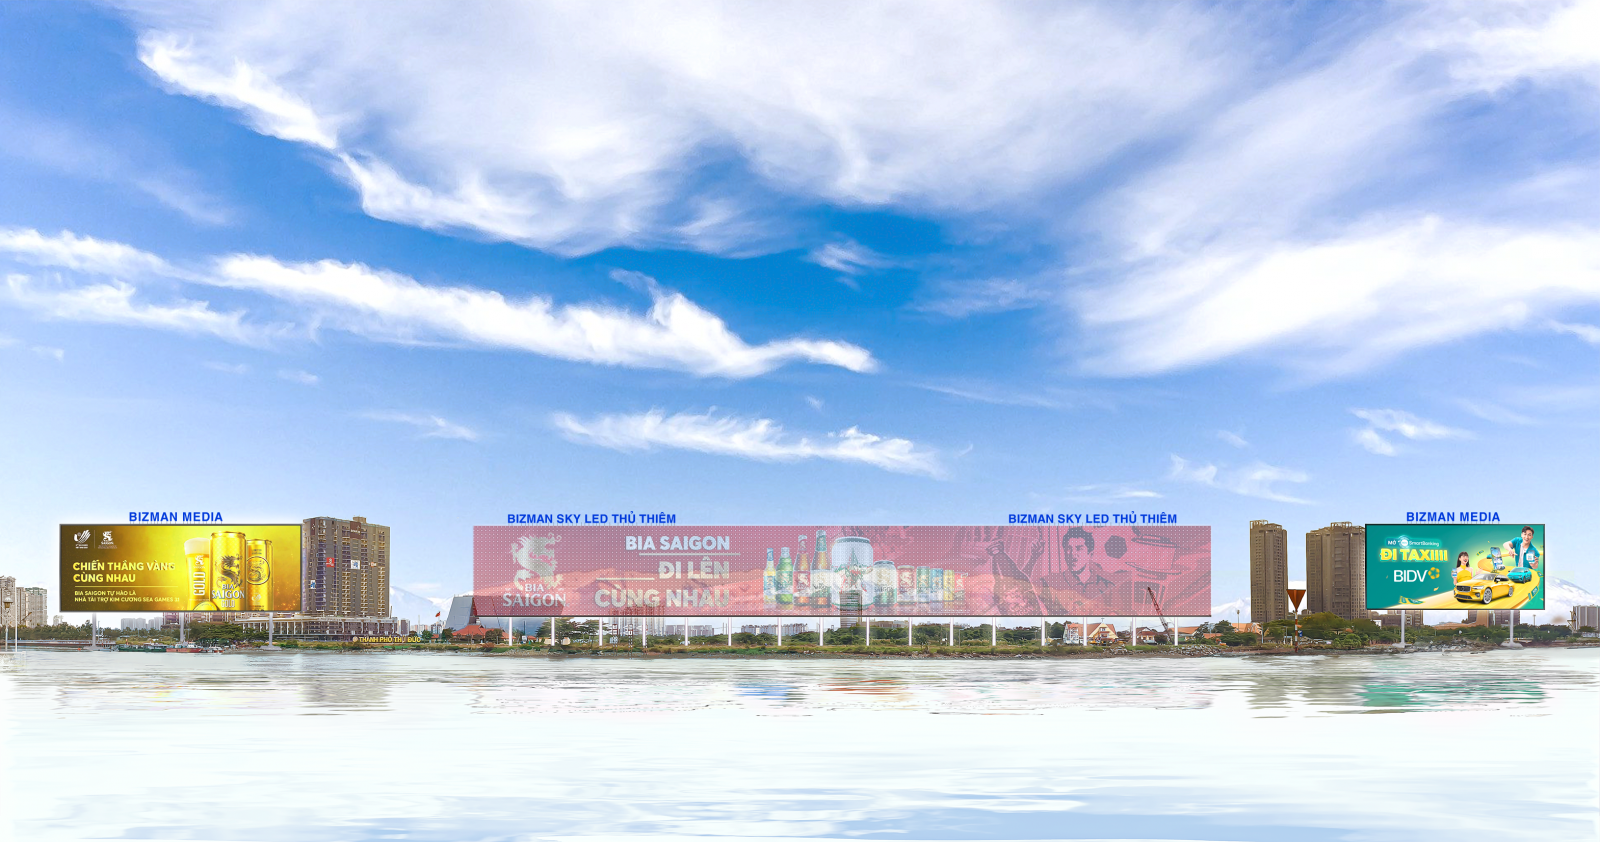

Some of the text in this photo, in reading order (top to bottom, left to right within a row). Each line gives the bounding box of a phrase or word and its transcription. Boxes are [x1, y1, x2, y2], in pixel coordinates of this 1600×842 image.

[129, 512, 223, 522] BIZMAN MEDIA
[507, 510, 677, 524] BIZMAN SKY LED THỦ THIÊM
[1008, 510, 1178, 524] BIZMAN SKY LED THỦ THIÊM
[1406, 512, 1500, 522] BIZMAN MEDIA
[625, 535, 730, 551] BIA SAIGON
[1379, 548, 1398, 561] ĐI
[687, 555, 730, 580] LÊN
[73, 572, 136, 582] CÙNG NHAU
[1393, 570, 1428, 582] BIDV
[193, 571, 206, 596] GOLD
[524, 583, 545, 592] BIA
[211, 590, 245, 599] SAIGON
[502, 593, 567, 607] SAIGON
[594, 583, 730, 608] CÙNG NHAU
